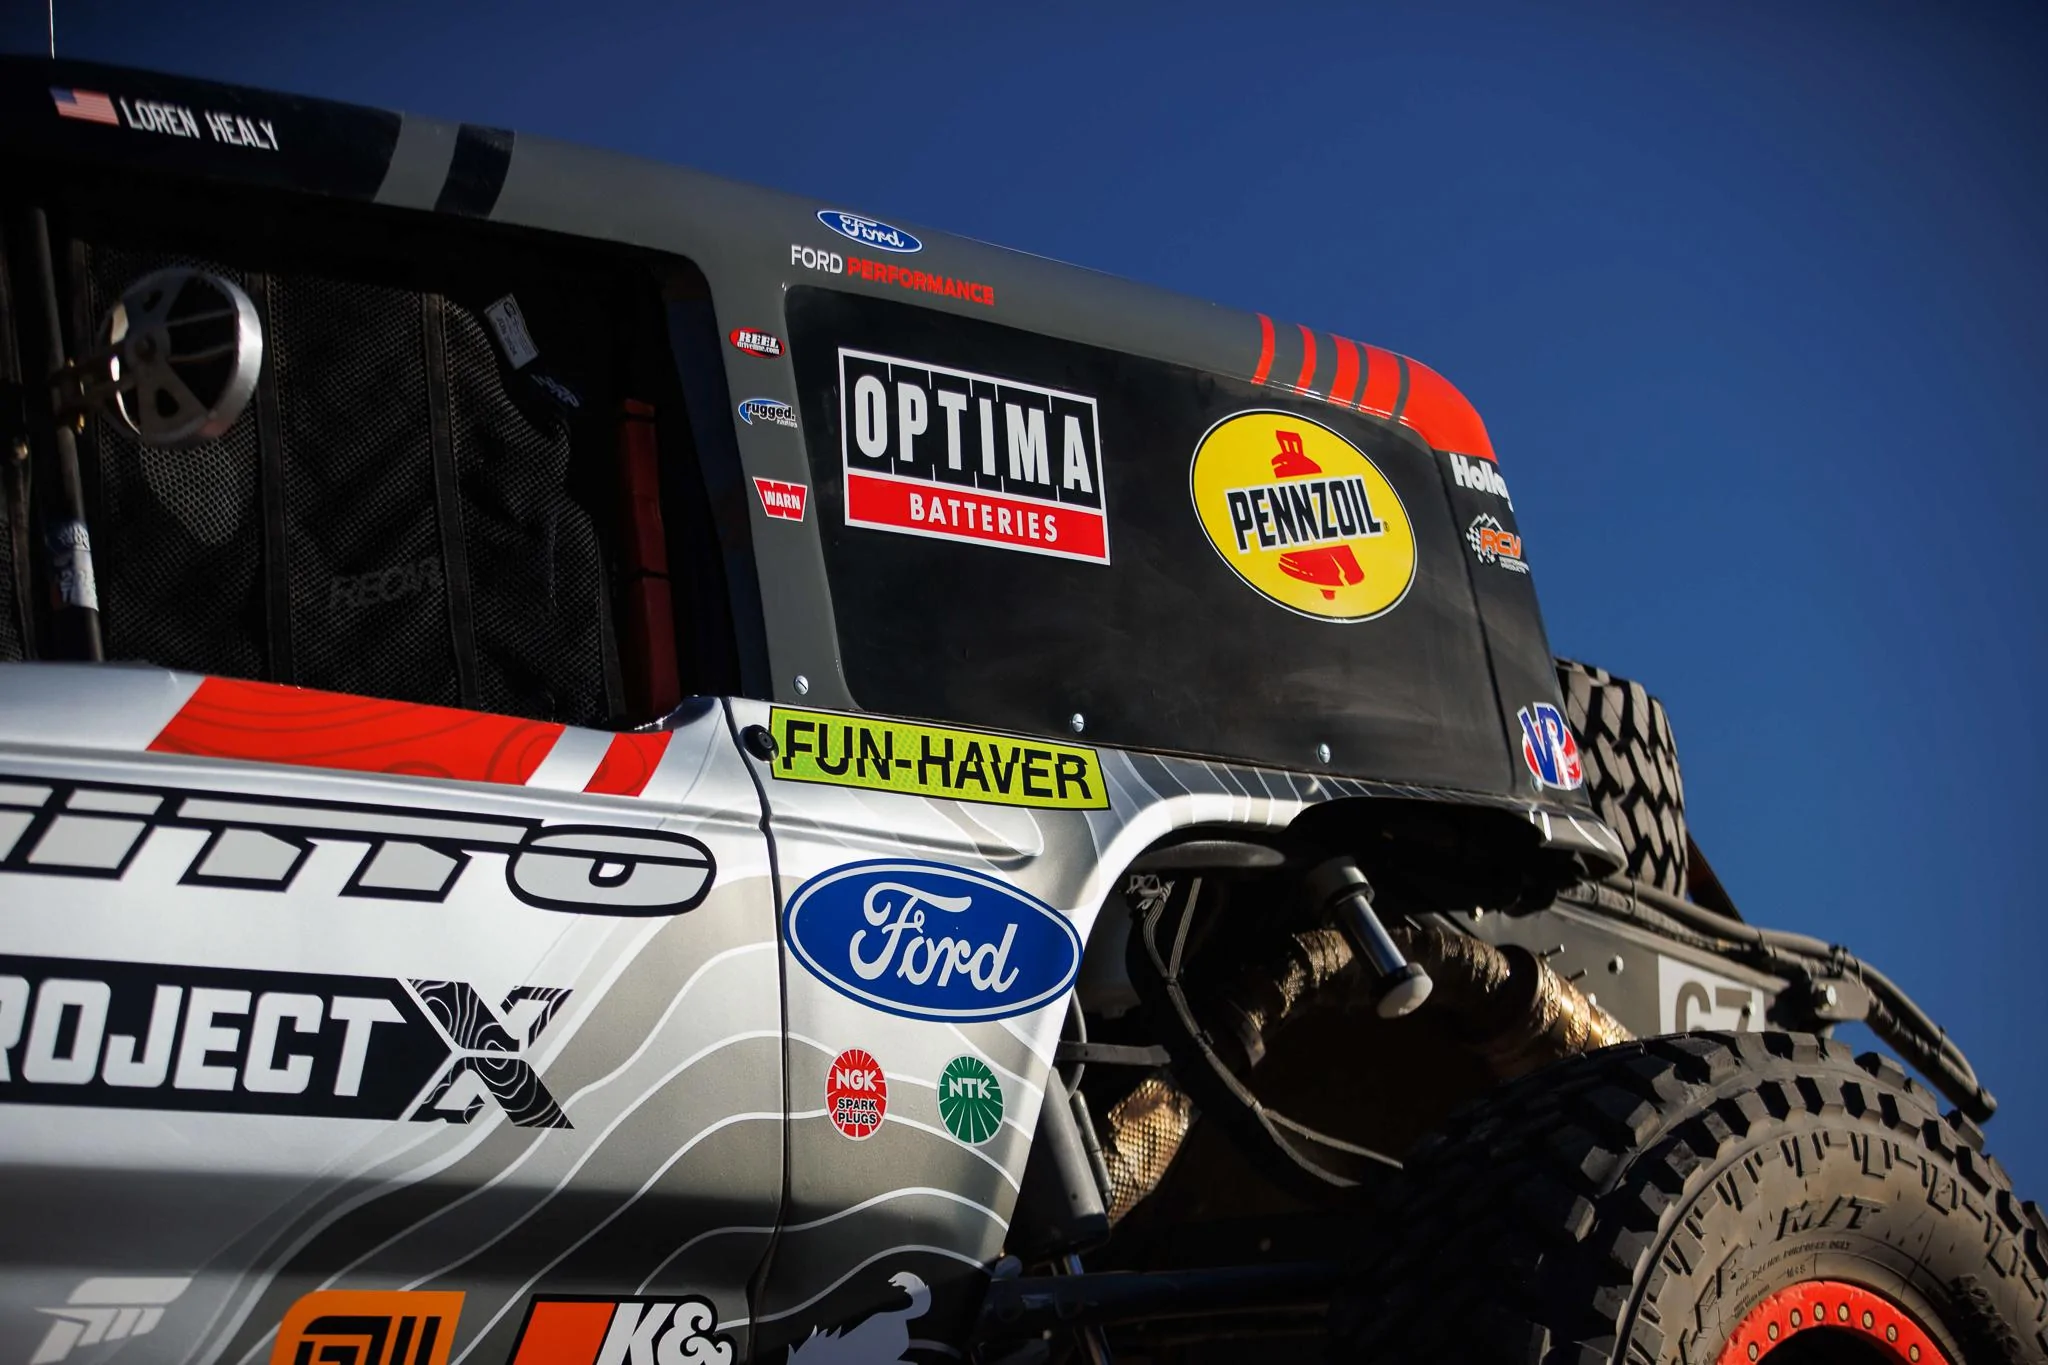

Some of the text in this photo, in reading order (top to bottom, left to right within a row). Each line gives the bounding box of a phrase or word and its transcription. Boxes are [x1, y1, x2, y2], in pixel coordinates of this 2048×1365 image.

[120, 96, 280, 151] LOREN HEALY
[839, 213, 904, 248] Ford
[791, 244, 995, 306] FORD PERFORMANCE
[739, 331, 779, 349] REEL
[854, 374, 1094, 494] OPTIMA
[764, 490, 801, 510] WARN
[909, 492, 1058, 542] BATTERIES
[1227, 478, 1381, 551] PENNZOIL
[1480, 526, 1521, 559] RCV
[782, 719, 1093, 799] FUN-HAVER
[849, 881, 1020, 993] Ford
[0, 974, 408, 1098] OJECT
[836, 1068, 877, 1092] NGK
[948, 1077, 992, 1100] NTK
[838, 1098, 876, 1111] SPARK
[838, 1112, 876, 1125] PLUGS
